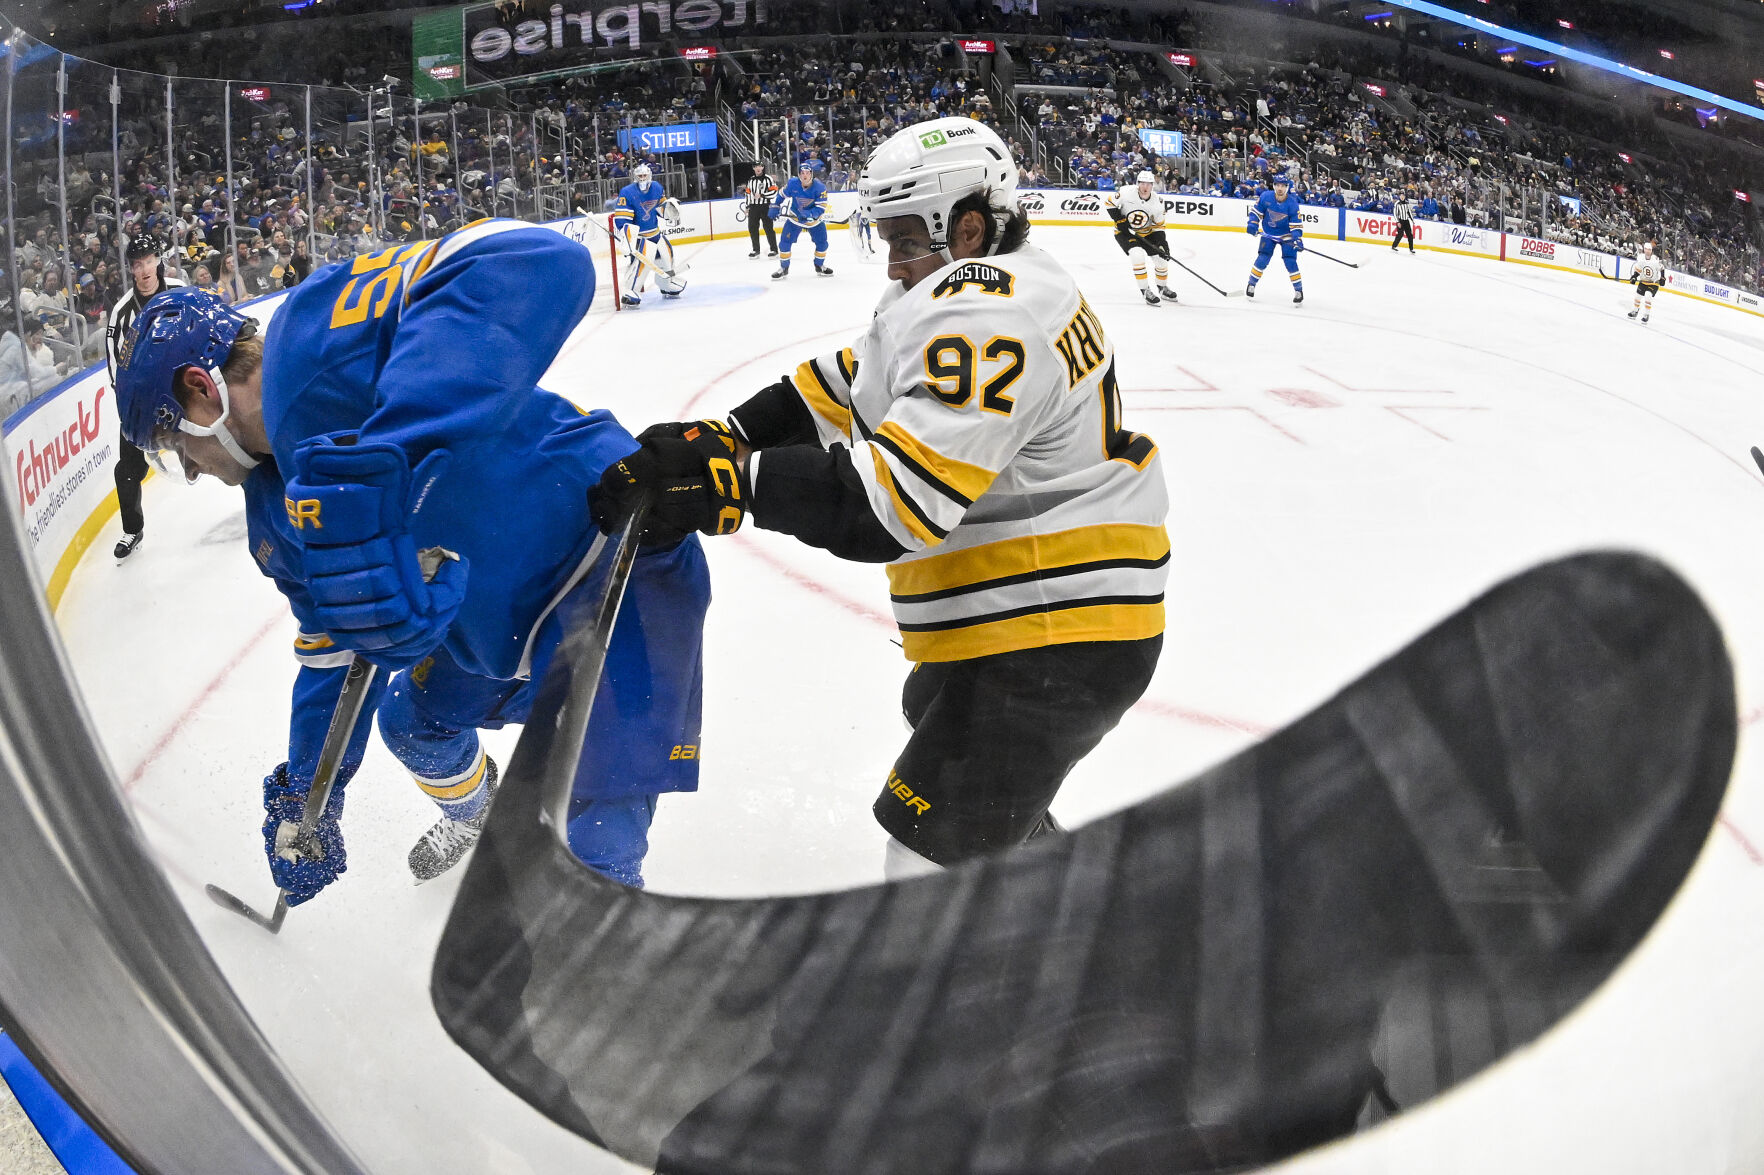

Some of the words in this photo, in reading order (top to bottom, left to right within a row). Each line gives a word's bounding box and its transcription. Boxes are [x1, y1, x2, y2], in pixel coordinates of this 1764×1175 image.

[641, 131, 695, 150] STIFEL
[920, 132, 943, 146] TD
[946, 127, 977, 138] Bank
[1060, 199, 1100, 212] Club
[1164, 201, 1214, 216] PEPSI
[1356, 217, 1423, 241] verizn
[1521, 238, 1556, 255] DOBBS
[948, 264, 1000, 283] BOSTON
[1704, 284, 1715, 295] BUD
[1715, 287, 1730, 298] LIGHT
[924, 333, 1026, 417] 92
[66, 466, 87, 497] stores
[85, 458, 94, 476] in
[93, 444, 112, 469] town
